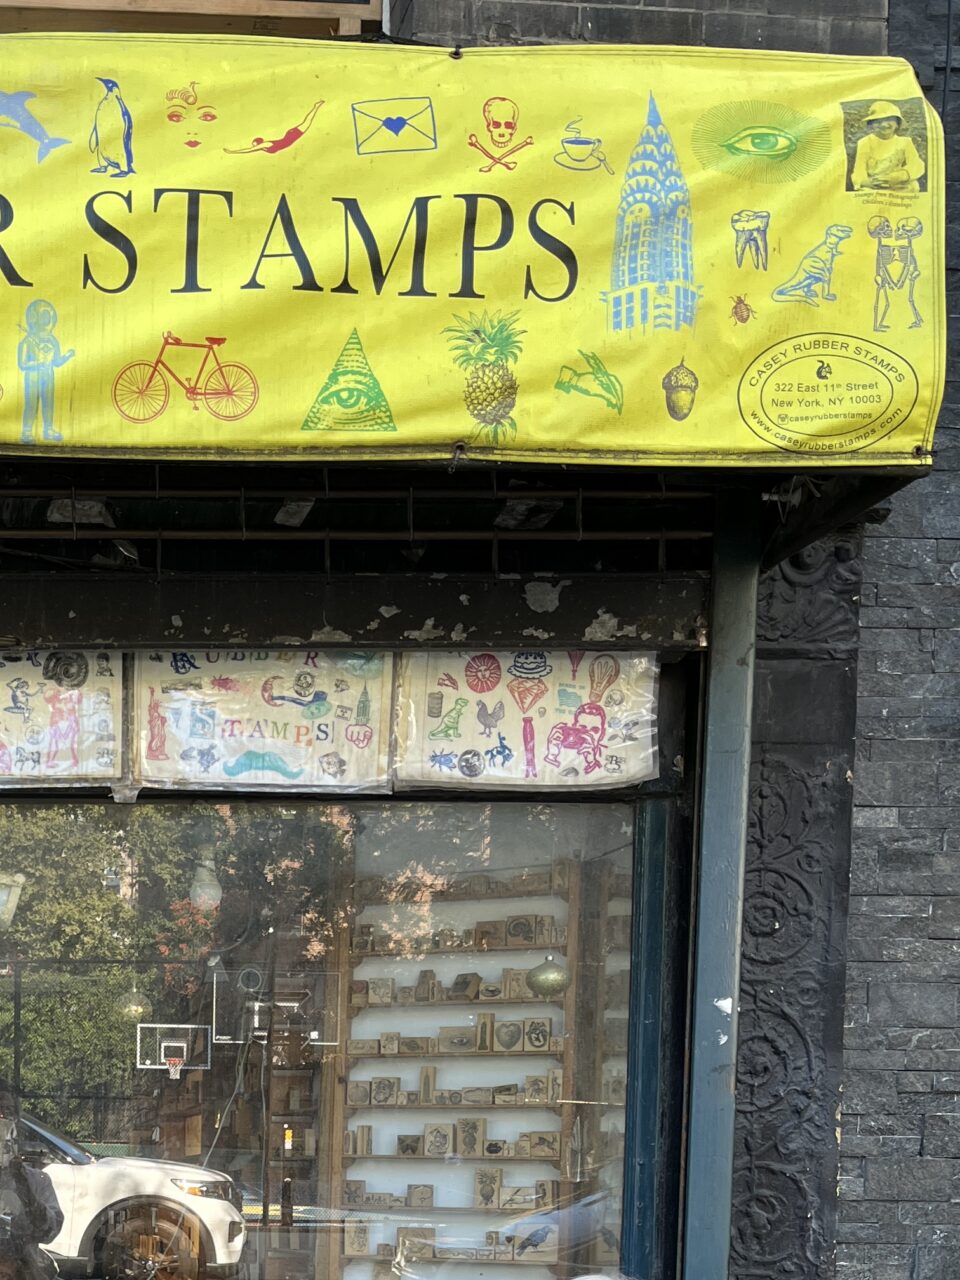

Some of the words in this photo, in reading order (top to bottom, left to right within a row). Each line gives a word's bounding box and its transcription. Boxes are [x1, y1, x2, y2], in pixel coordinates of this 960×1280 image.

[83, 188, 579, 302] STAMPS
[749, 348, 788, 388] CASEY
[792, 339, 850, 354] RUBBER
[853, 346, 906, 383] STAMPS
[771, 398, 793, 408] New
[797, 398, 824, 408] York,
[828, 396, 844, 406] NY
[849, 394, 882, 405] 10003
[774, 383, 793, 392] 322
[797, 383, 820, 393] East
[845, 381, 879, 392] Street
[750, 406, 903, 451] www.caseyrubberstamps.com
[789, 411, 873, 423] caseyrubberstamps
